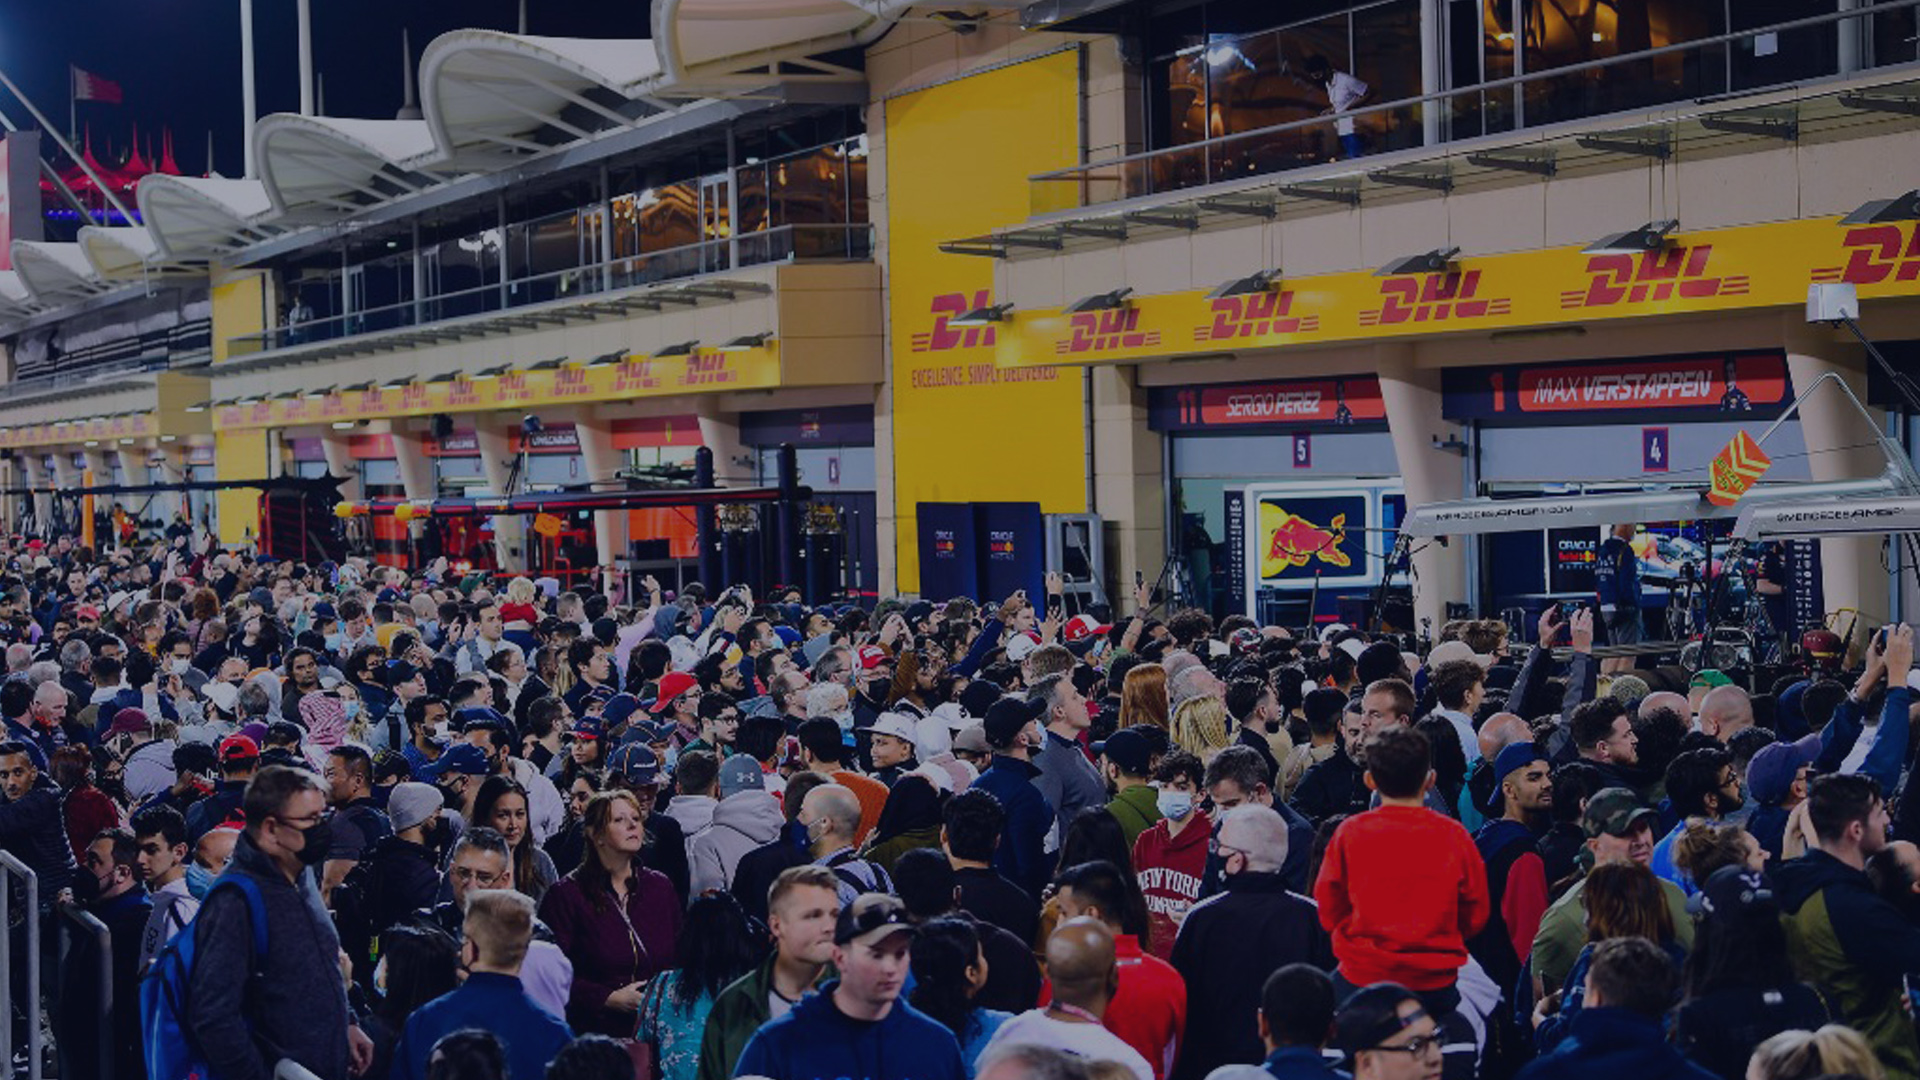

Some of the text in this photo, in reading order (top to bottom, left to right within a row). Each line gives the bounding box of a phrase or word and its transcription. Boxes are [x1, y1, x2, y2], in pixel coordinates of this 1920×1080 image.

[1584, 244, 1722, 307] DHL
[1210, 290, 1300, 340] DHL
[1379, 270, 1489, 325] DHL
[930, 290, 996, 351] DH
[1069, 308, 1146, 352] DHL
[1226, 393, 1275, 417] SERGIO
[1275, 391, 1322, 414] PEREZ
[1489, 370, 1713, 412] 1 MAX VERSTAPPEN
[1297, 438, 1307, 462] 5
[1650, 437, 1662, 462] 4
[1558, 540, 1596, 551] ORACLE
[1165, 868, 1203, 899] YORK
